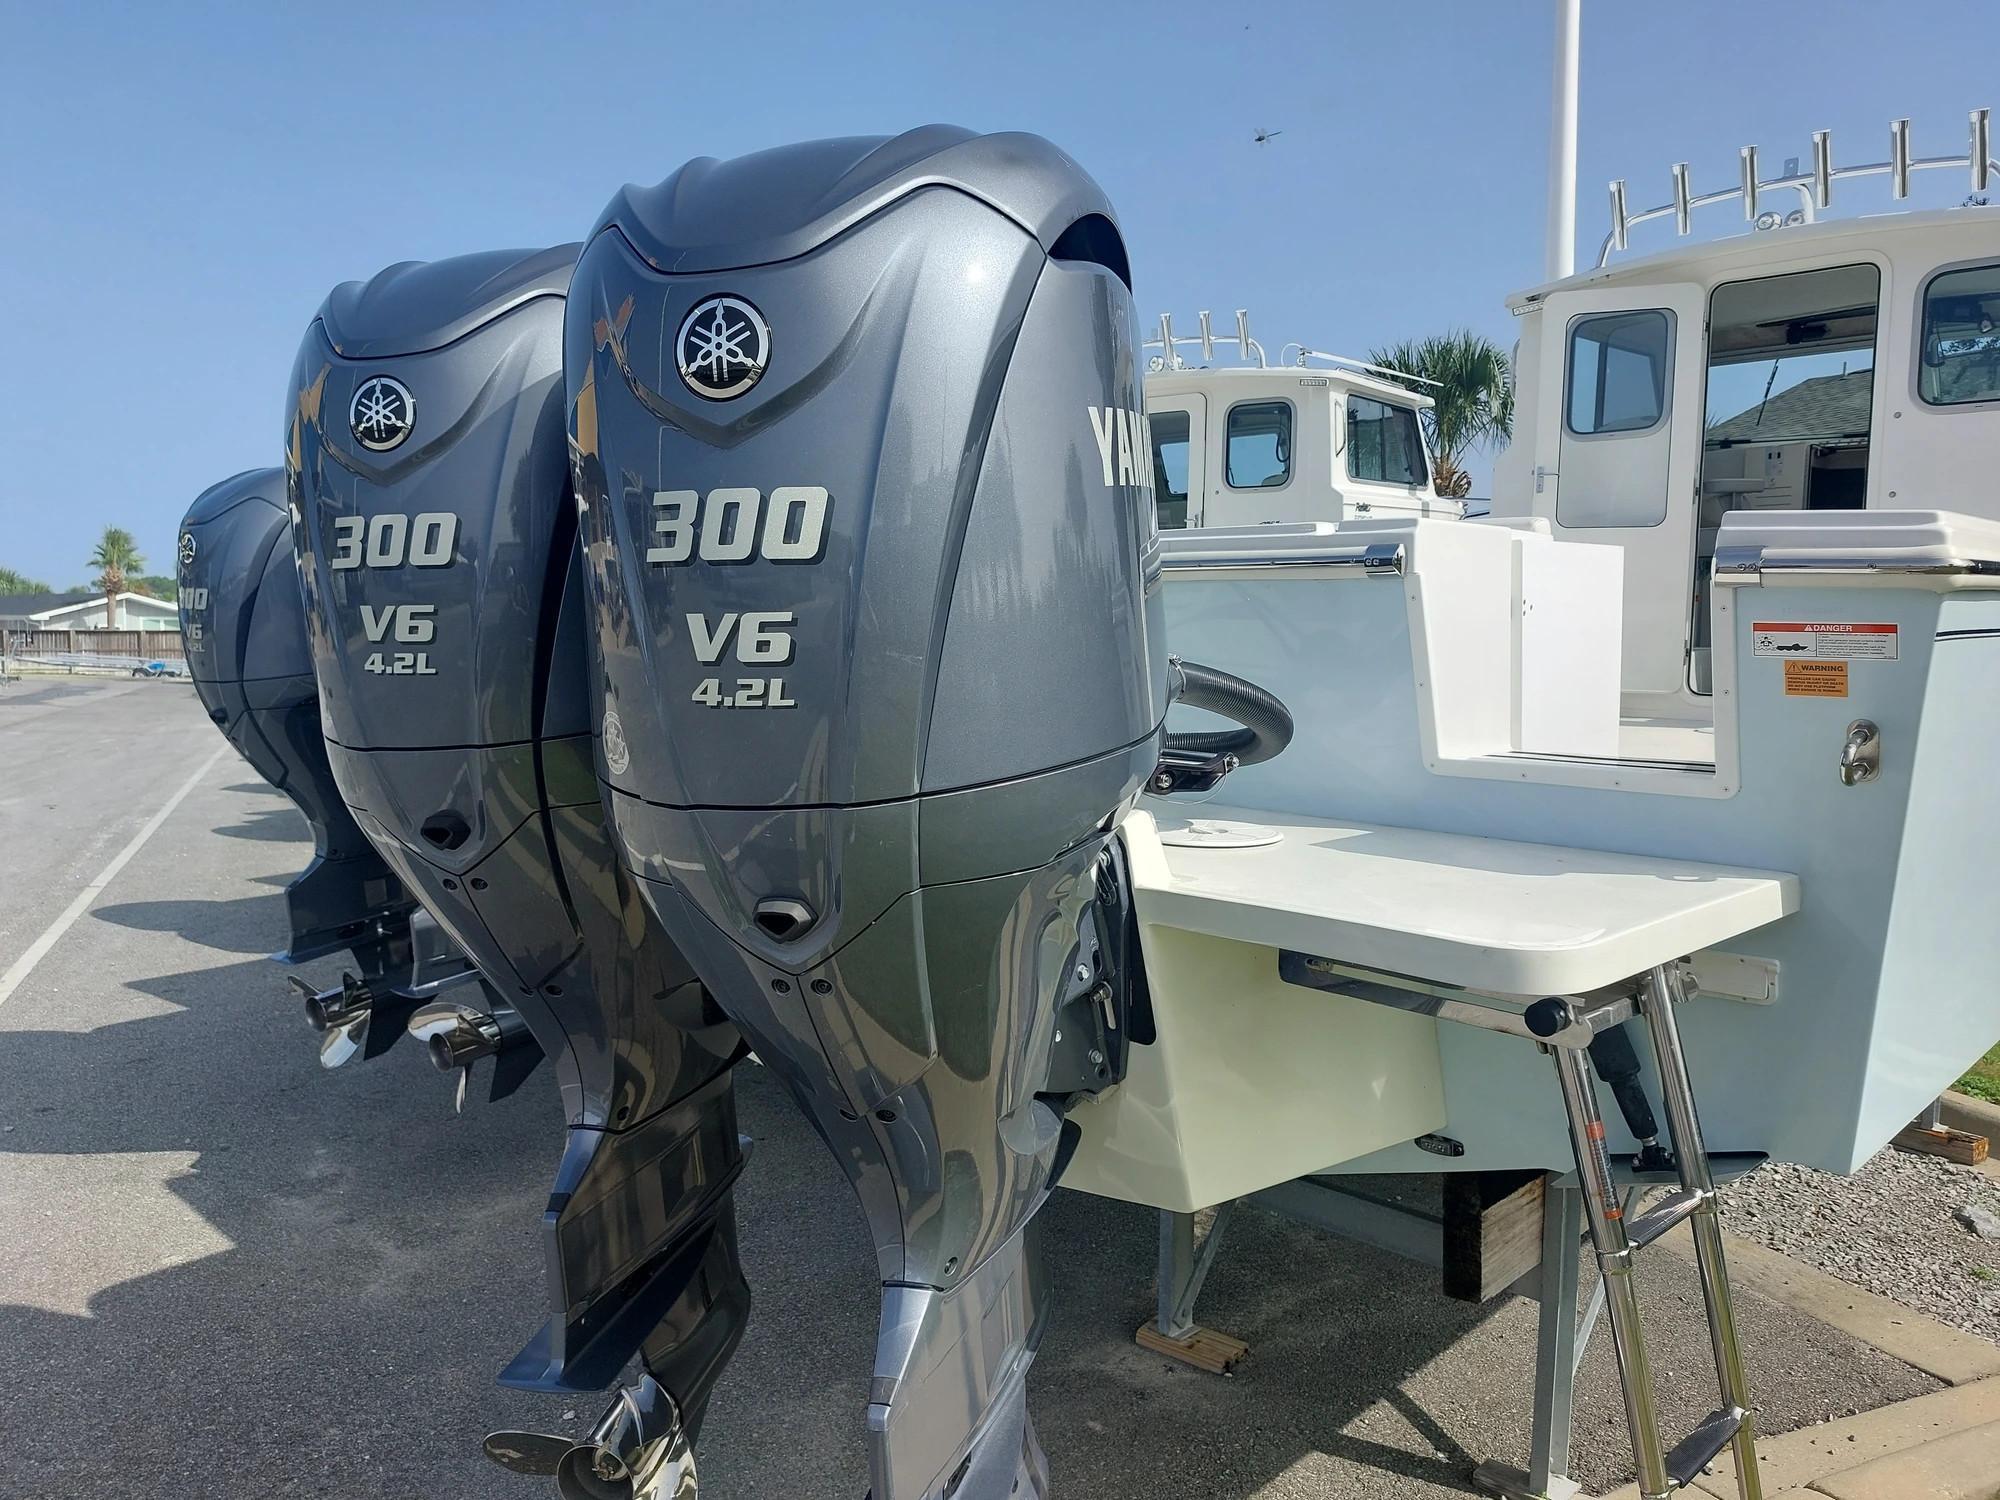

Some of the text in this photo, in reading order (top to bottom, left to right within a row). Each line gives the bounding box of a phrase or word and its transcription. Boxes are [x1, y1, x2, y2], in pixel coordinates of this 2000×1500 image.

[332, 512, 460, 570] 300
[646, 486, 832, 565] 300
[360, 604, 438, 643] V6
[686, 611, 796, 664] V6
[1813, 624, 1853, 632] DANGER
[365, 652, 437, 675] 4.2L
[1801, 664, 1844, 672] WARNING
[691, 677, 796, 708] 4.2L
